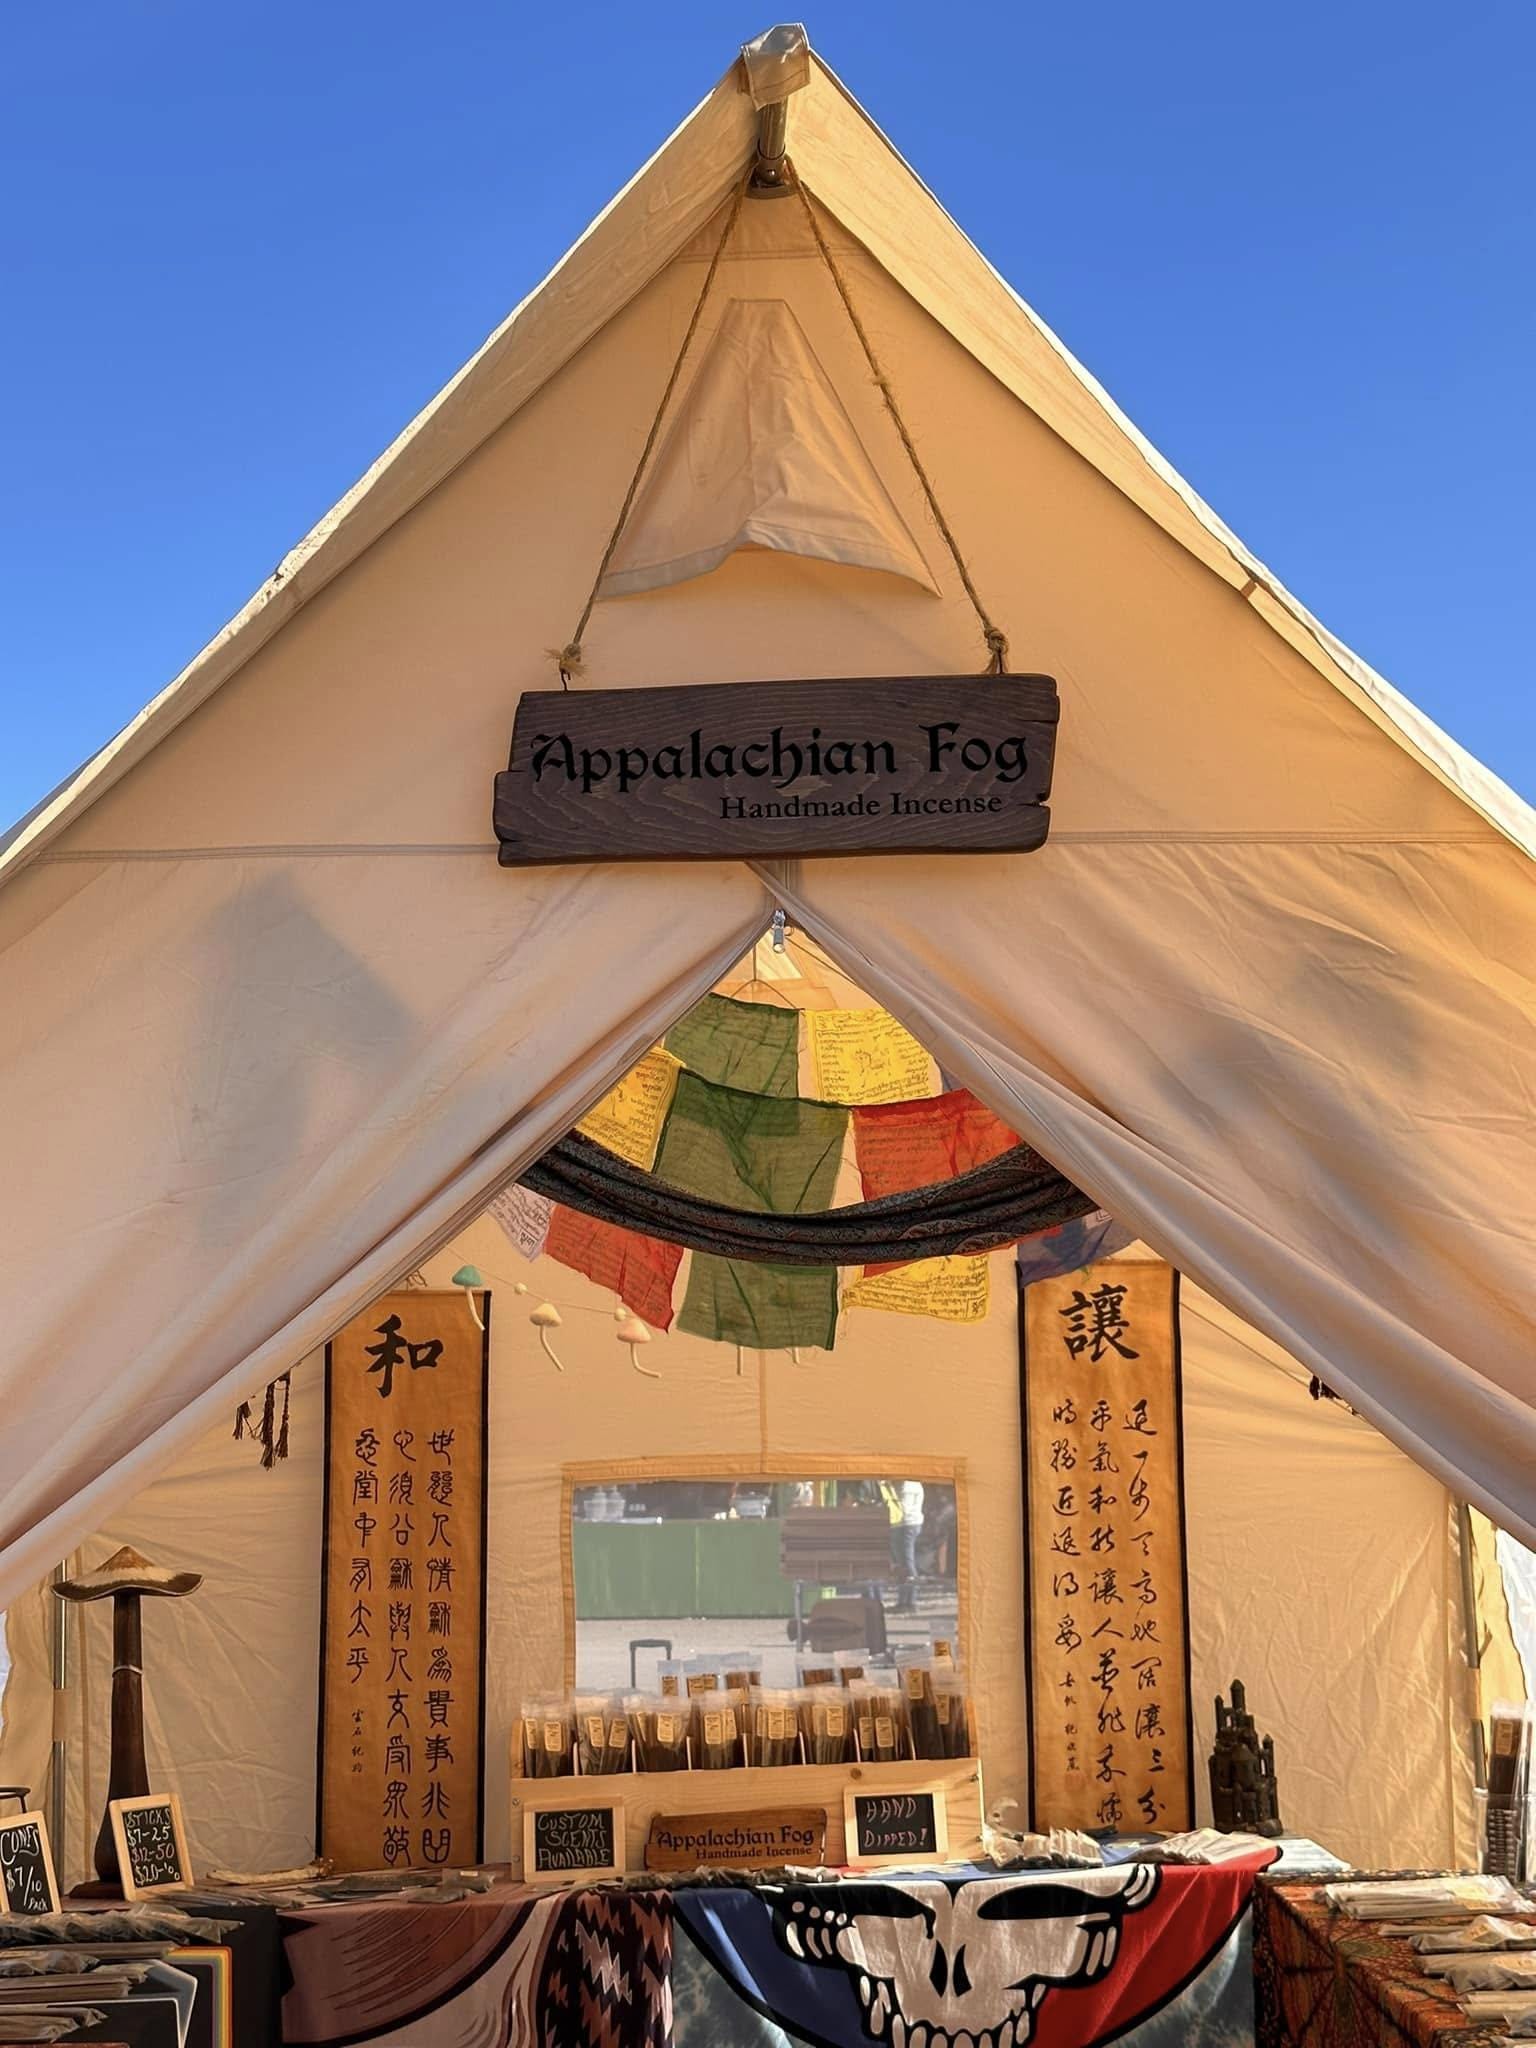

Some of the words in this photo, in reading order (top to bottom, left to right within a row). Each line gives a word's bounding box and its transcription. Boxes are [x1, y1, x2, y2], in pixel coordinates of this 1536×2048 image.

[530, 728, 897, 794] Appalachian
[918, 721, 1029, 783] Fog
[719, 795, 882, 820] Handmade
[890, 793, 1003, 817] Incense
[364, 1314, 444, 1398] 和
[125, 1807, 170, 1828] STICKS
[866, 1796, 917, 1824] HAND
[0, 1825, 40, 1865] CONES
[545, 1829, 608, 1848] SCENTS
[656, 1828, 775, 1852] Appalachian
[779, 1824, 815, 1845] Fog
[864, 1827, 929, 1848] DIPPED!
[538, 1847, 611, 1869] AVAILABLE
[695, 1848, 762, 1860] Handmade
[766, 1846, 813, 1857] Incense
